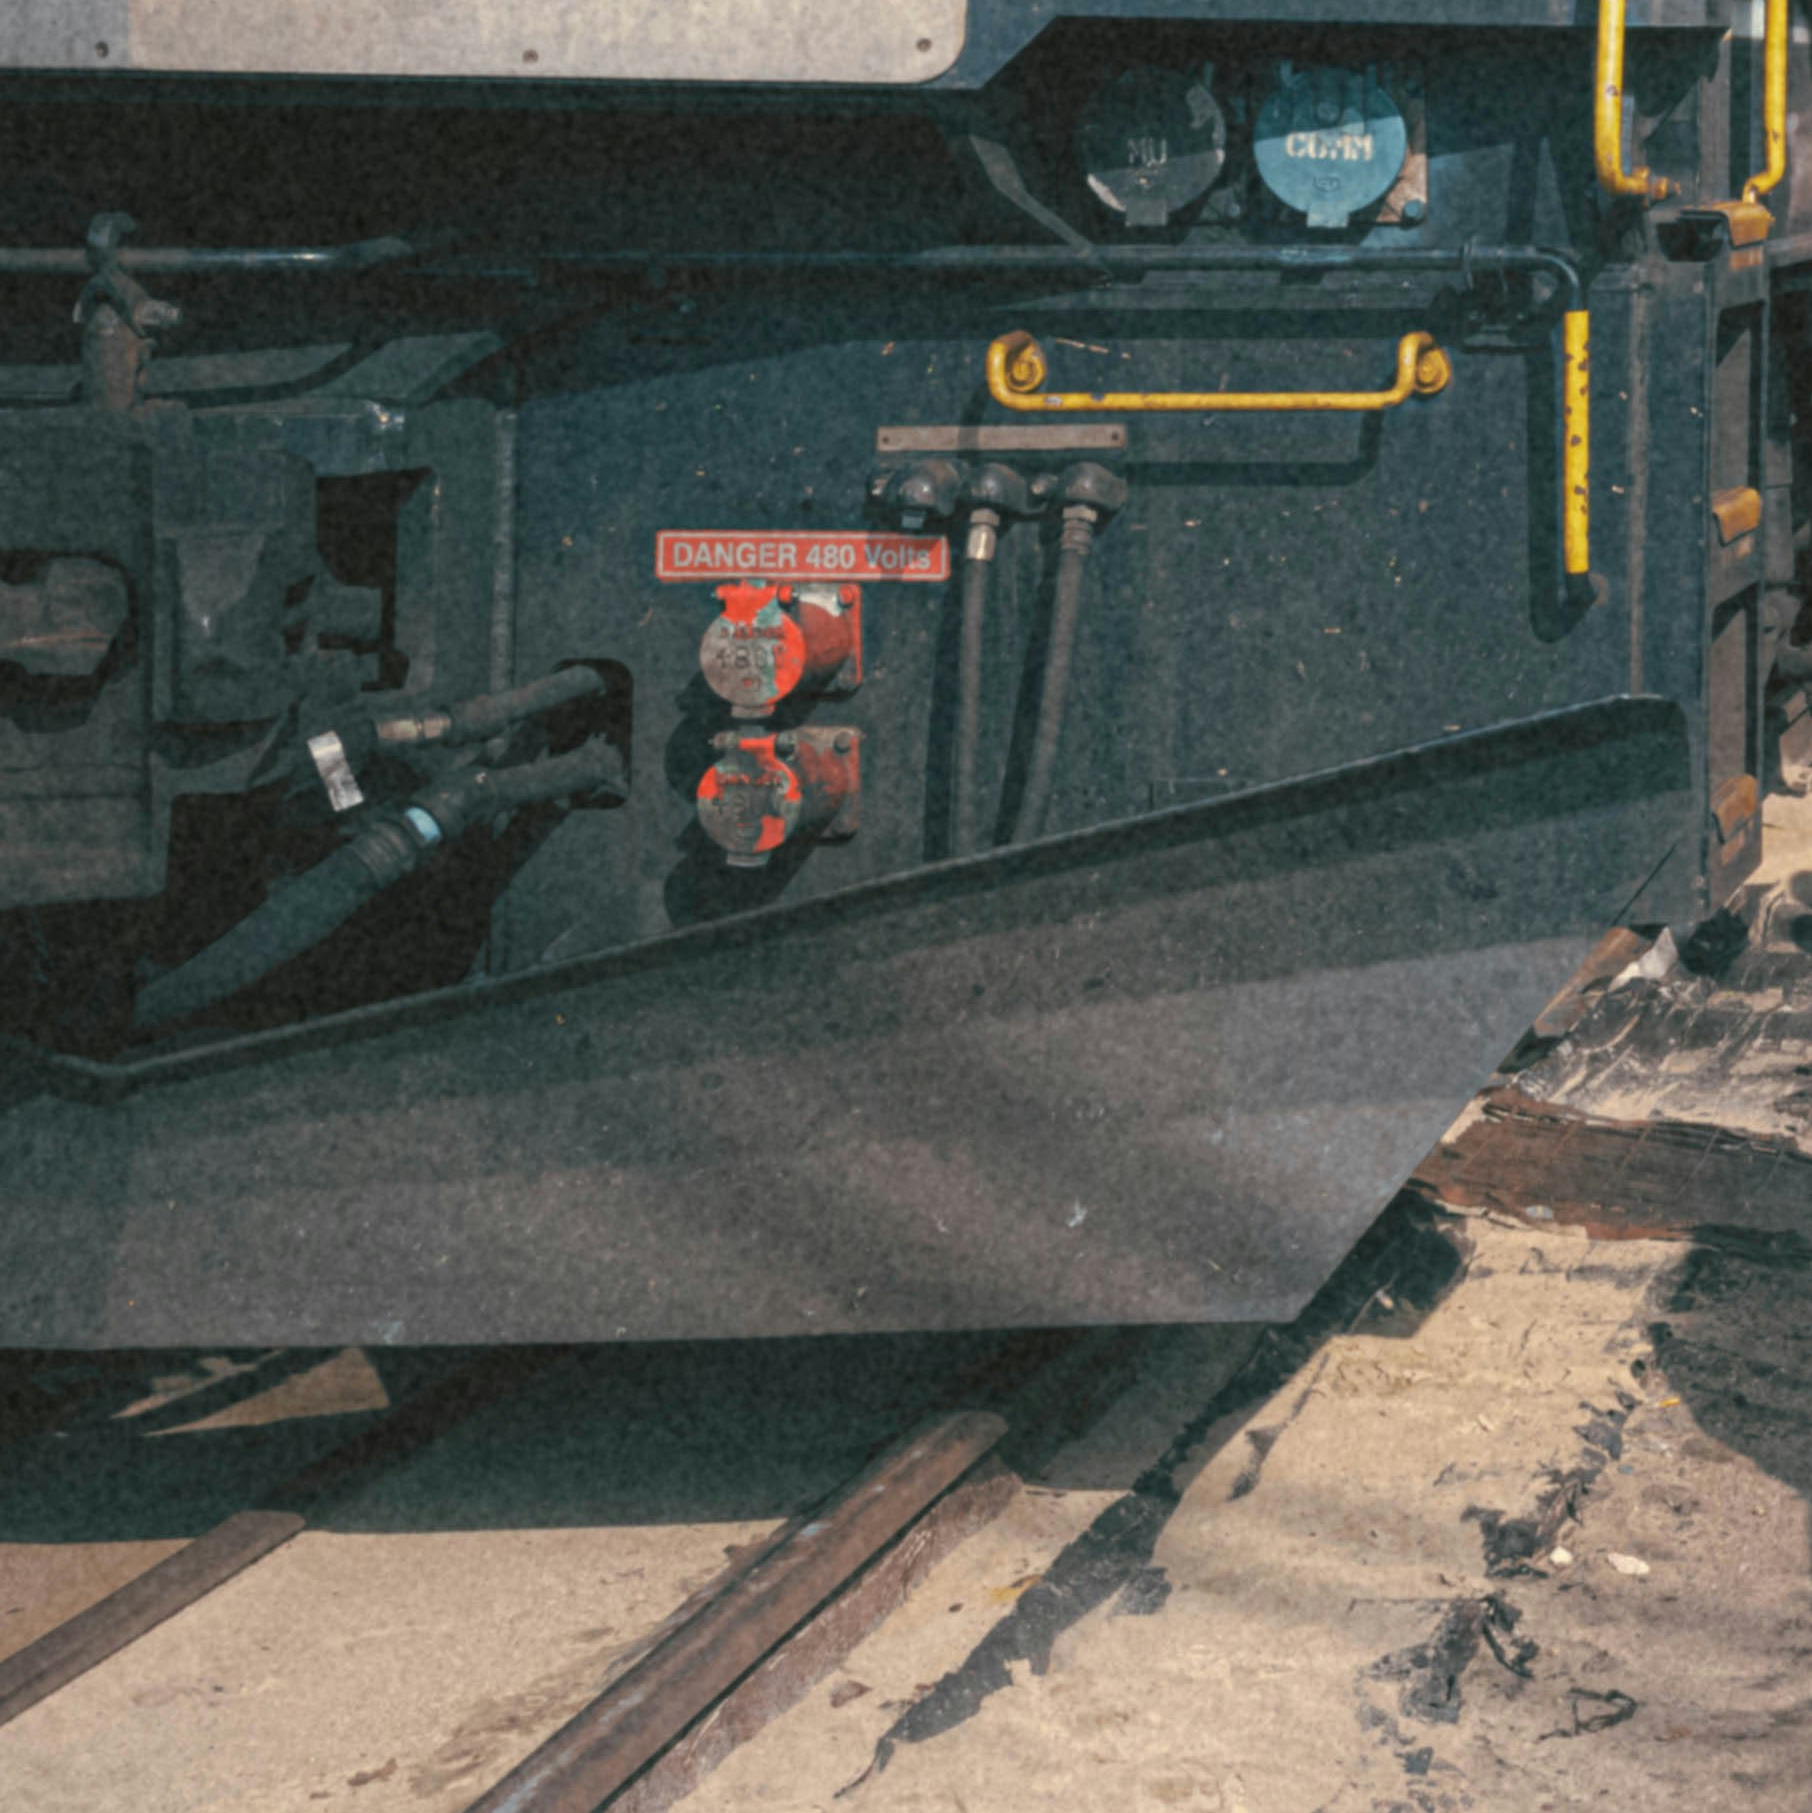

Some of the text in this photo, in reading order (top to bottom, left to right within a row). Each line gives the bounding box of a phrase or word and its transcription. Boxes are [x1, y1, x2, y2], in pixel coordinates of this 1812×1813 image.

[1285, 131, 1374, 161] COMM
[673, 542, 932, 571] DANGER 480 Volts
